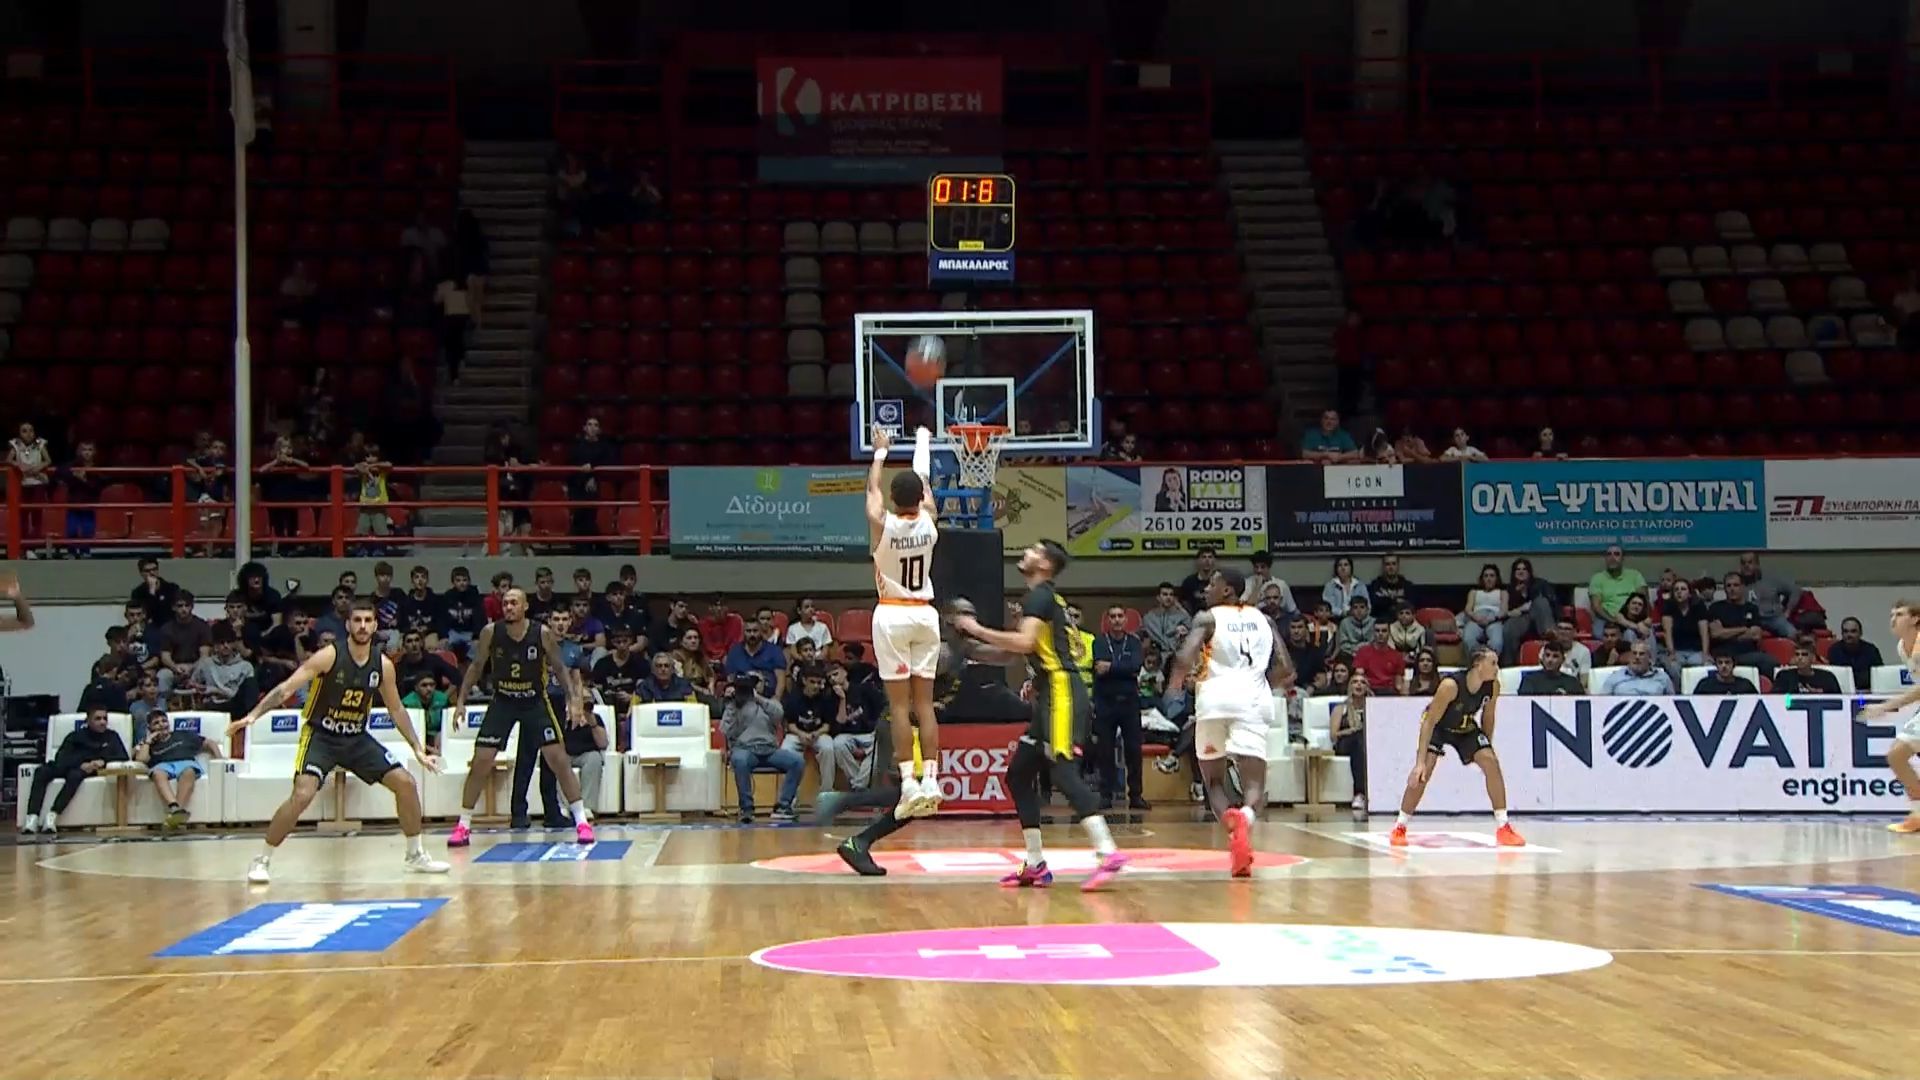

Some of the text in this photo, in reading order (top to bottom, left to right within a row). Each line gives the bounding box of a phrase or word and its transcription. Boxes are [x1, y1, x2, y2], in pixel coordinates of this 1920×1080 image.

[829, 92, 983, 112] ΚΑΤΡΙΒΕΣΗ
[938, 259, 1009, 271] ΜΠΑΚΑΛΑΡΟΣ
[1347, 476, 1383, 488] ICON
[1470, 480, 1759, 514] ΟΛΑ-ΨΗΝΟΝΤΑΙ
[725, 494, 812, 520] Δίδυμοι
[1824, 500, 1902, 511] ΞΥΛΕΜΠΟΡΙΚΗ
[1144, 516, 1263, 531] 2610 205 205
[1312, 524, 1328, 534] ΣΤΟ
[1330, 523, 1362, 534] ΚΕΝΤΡΟ
[1365, 523, 1379, 533] ΤΗΣ
[1535, 519, 1694, 530] ΨΗΤΟΠΩΛΕΙΟ ΕΣΤΙΑΤΟΡΙΟ
[899, 554, 924, 592] 10
[1240, 637, 1253, 666] 4
[510, 663, 521, 678] 2
[341, 688, 364, 708] 23
